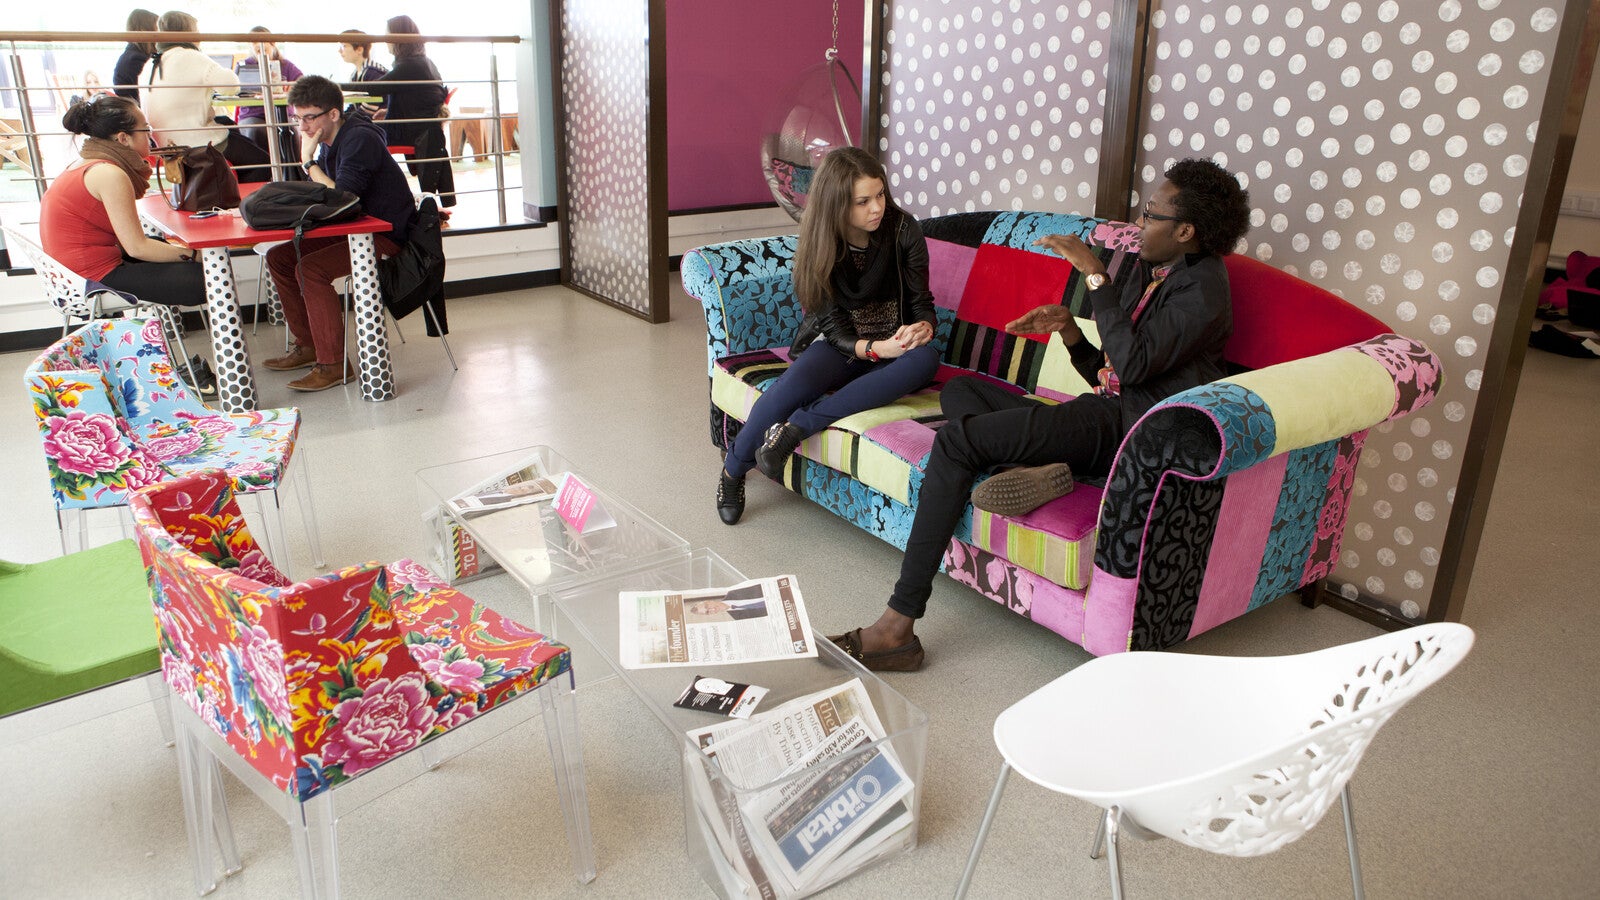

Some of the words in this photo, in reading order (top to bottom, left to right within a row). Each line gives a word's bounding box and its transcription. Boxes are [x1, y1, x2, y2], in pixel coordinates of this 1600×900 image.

[464, 554, 475, 570] TO
[772, 721, 782, 736] By
[784, 716, 796, 740] Case
[794, 712, 813, 751] Discrim
[845, 721, 859, 736] calls
[836, 729, 866, 754] Coroner's
[837, 732, 847, 743] for
[824, 740, 838, 754] A30
[806, 752, 825, 767] safety
[764, 795, 791, 821] renewed
[796, 775, 881, 855] Orbital
